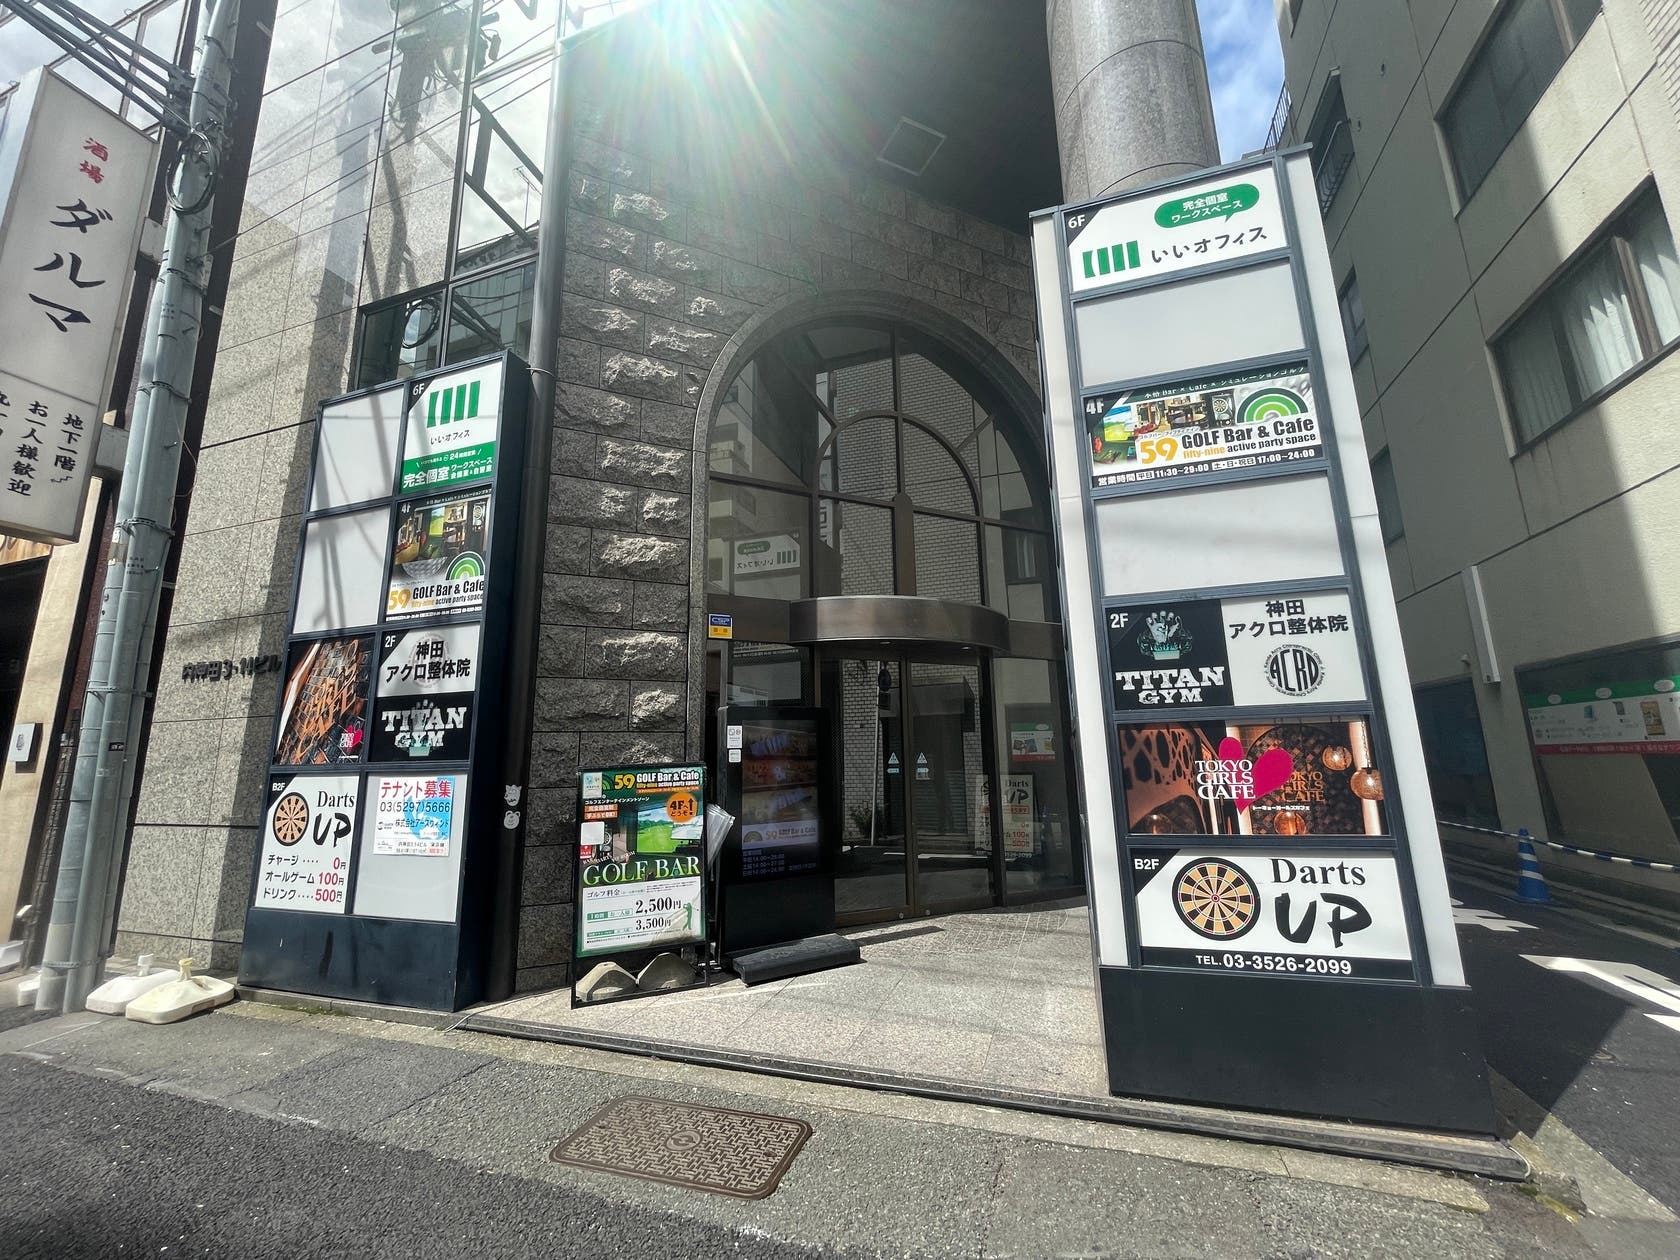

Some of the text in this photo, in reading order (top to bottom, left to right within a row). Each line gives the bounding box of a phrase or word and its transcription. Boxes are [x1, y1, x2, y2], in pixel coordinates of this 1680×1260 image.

[79, 136, 109, 185] 酒場
[1182, 192, 1229, 212] 完全個室
[1171, 200, 1243, 223] ワークスペース
[1067, 214, 1086, 229] 6F
[1151, 227, 1268, 263] いいオフィス
[28, 198, 114, 333] ダルマ
[413, 383, 425, 396] 6F
[1162, 388, 1176, 397] Bar
[1085, 400, 1105, 415] 4F
[54, 413, 84, 471] 地下一階
[430, 430, 470, 445] いいオフィス
[1181, 417, 1315, 450] GOLF Bar & Cafe
[7, 401, 49, 496] お一人様歓迎
[1139, 437, 1178, 464] 59
[1182, 432, 1316, 460] fifty-nine active party space
[451, 457, 493, 471] ワークスペース
[403, 466, 450, 489] 完全個室
[1097, 473, 1136, 486] 営業時間
[412, 584, 435, 600] GOLF
[436, 583, 453, 598] Bar
[453, 583, 461, 595] &
[463, 580, 485, 593] Cafe
[388, 588, 411, 611] 59
[435, 597, 452, 606] active
[452, 595, 466, 605] party
[466, 593, 483, 603] space
[1265, 599, 1306, 618] 神田
[1110, 613, 1129, 629] 2F
[1229, 615, 1349, 639] アクロ整体院
[385, 636, 397, 648] 2F
[416, 640, 445, 660] 神田
[386, 658, 471, 683] アクロ整体院
[1115, 666, 1225, 691] TITAN
[1138, 687, 1203, 705] GYM
[381, 706, 467, 732] TITAN
[395, 730, 445, 748] GYM
[1195, 759, 1254, 772] TOKYO
[614, 773, 636, 790] 59
[637, 771, 699, 783] GOLF Bar & Cafe
[1196, 771, 1254, 785] GIRLS
[272, 782, 286, 791] B2F
[381, 780, 451, 799] テナント募集
[1198, 784, 1256, 800] CAFE
[317, 790, 355, 808] Darts
[380, 801, 451, 813] 03(5297)5666
[313, 812, 352, 848] UP
[268, 854, 346, 870] チャージ 0円
[583, 860, 648, 886] GOLF
[655, 856, 701, 878] BAR
[1134, 858, 1160, 870] B2F
[265, 871, 344, 886] オールゲーム 100円
[1268, 857, 1367, 886] Darts
[264, 887, 296, 900] ドリンク
[635, 897, 682, 914] 2,500円
[635, 917, 671, 931] 3,500円
[1275, 892, 1373, 949] UP
[1196, 953, 1352, 975] TEL. 03-3526-2099
